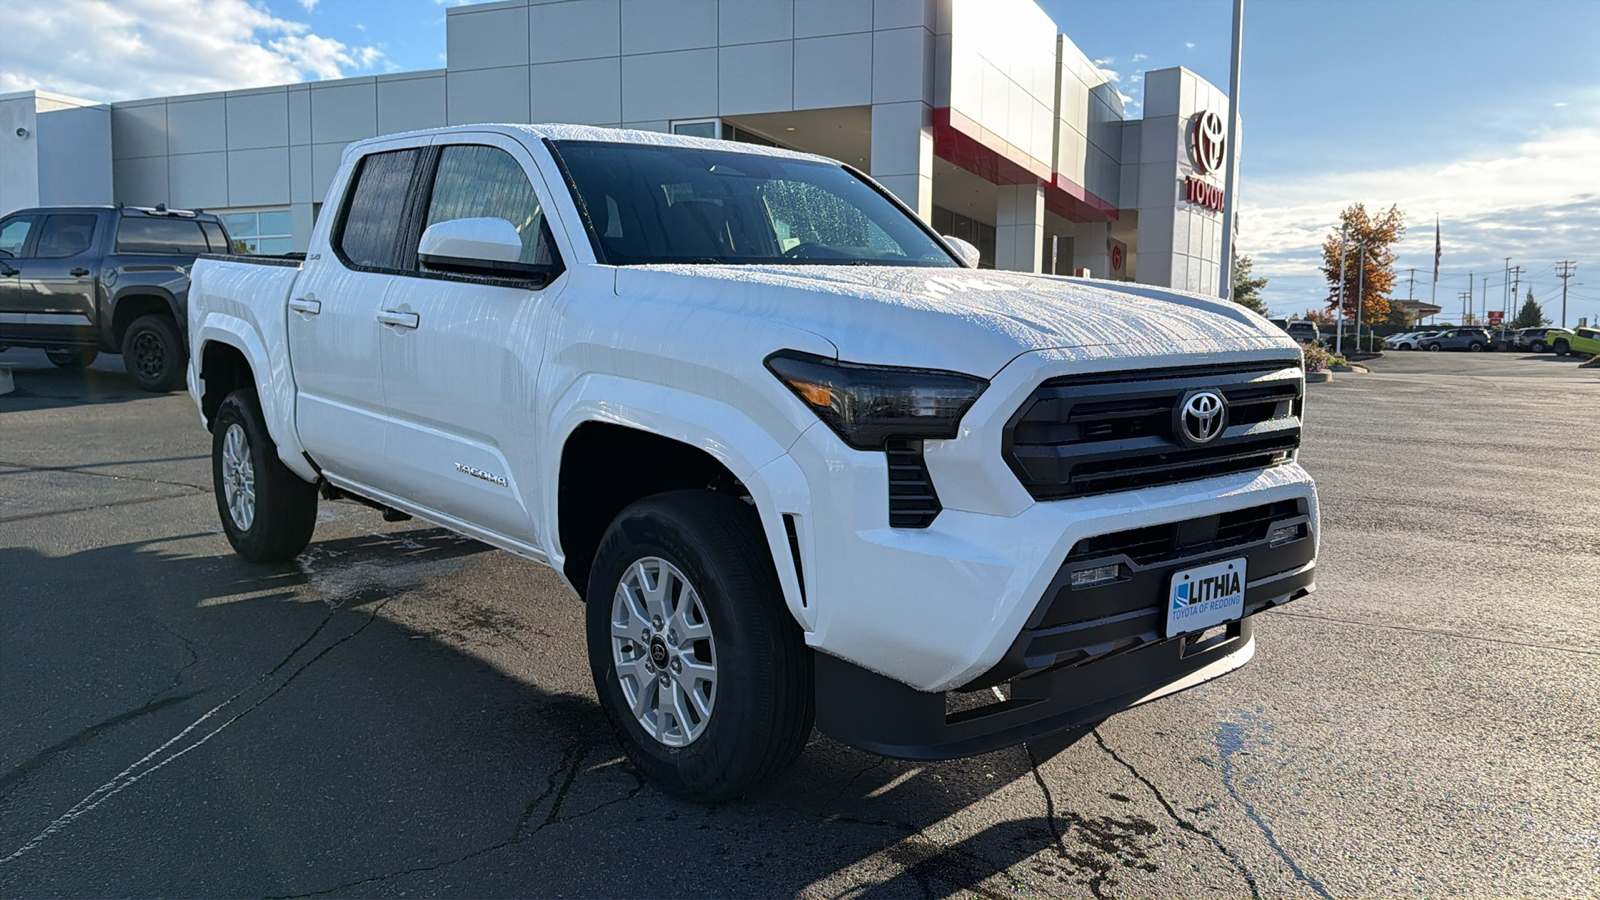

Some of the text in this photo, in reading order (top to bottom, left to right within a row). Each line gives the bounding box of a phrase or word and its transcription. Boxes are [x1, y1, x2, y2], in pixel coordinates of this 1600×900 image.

[454, 462, 508, 487] TACOMA
[1189, 571, 1241, 605] LITHIA
[1172, 595, 1241, 621] TOYOTA OF REDDING
